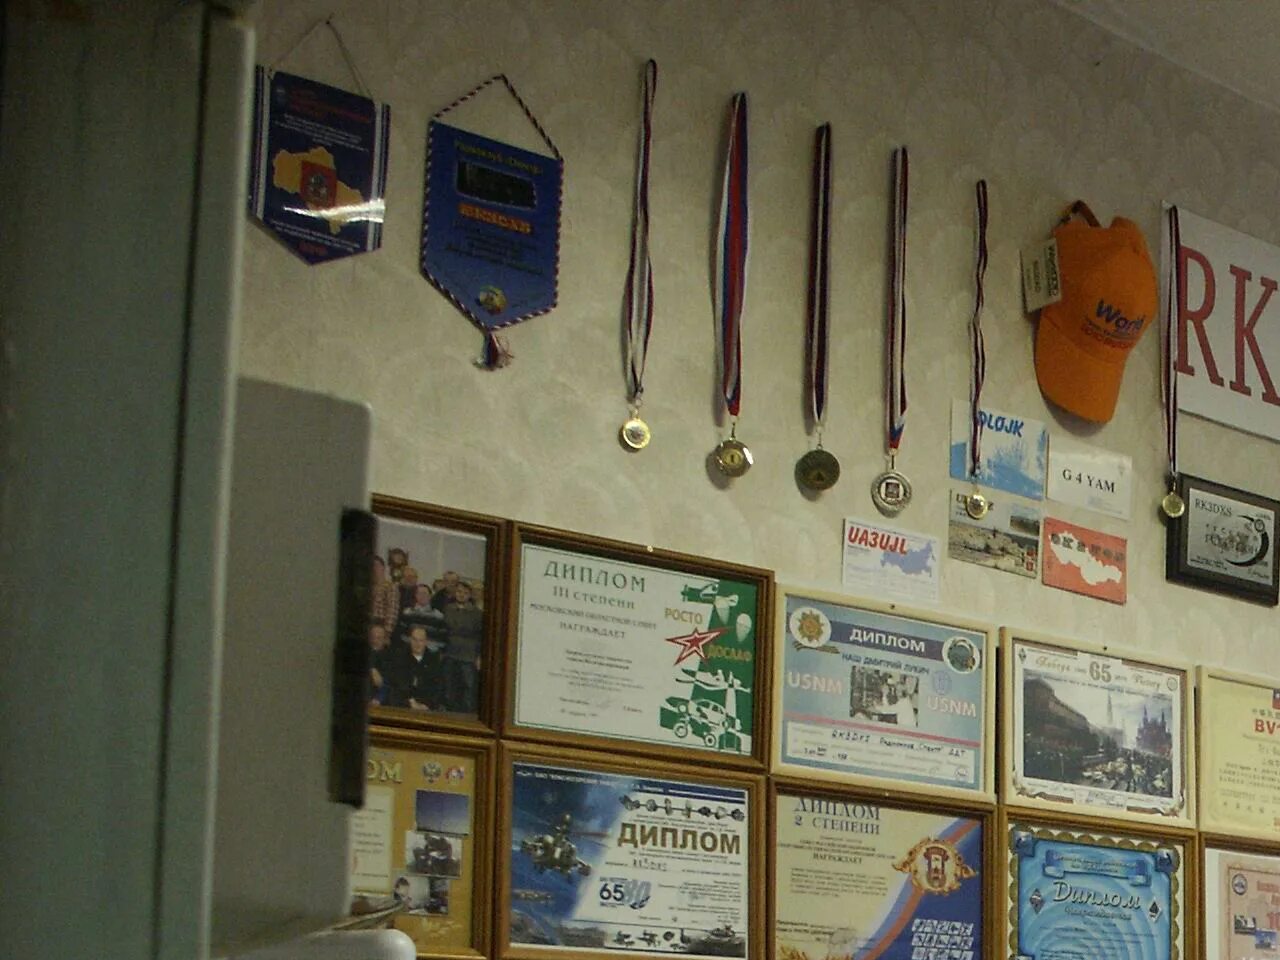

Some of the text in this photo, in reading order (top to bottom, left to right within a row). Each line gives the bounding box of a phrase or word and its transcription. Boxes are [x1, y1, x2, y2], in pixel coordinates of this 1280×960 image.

[1195, 498, 1232, 517] RK3DXS
[847, 526, 907, 555] UA3UJL
[544, 560, 646, 593] ДИПЛОМ
[552, 585, 635, 610] III степени
[664, 607, 703, 625] РОСТО
[560, 621, 626, 640] НАГРАЖДАЕТ
[850, 629, 925, 653] ДИПЛОМ
[1089, 661, 1112, 683] 65
[794, 797, 880, 821] ДИПЛОМ
[812, 816, 880, 835] СТЕПЕНИ
[617, 822, 741, 854] ДИПЛОМ
[600, 883, 625, 901] 65
[1053, 881, 1141, 910] Диплом
